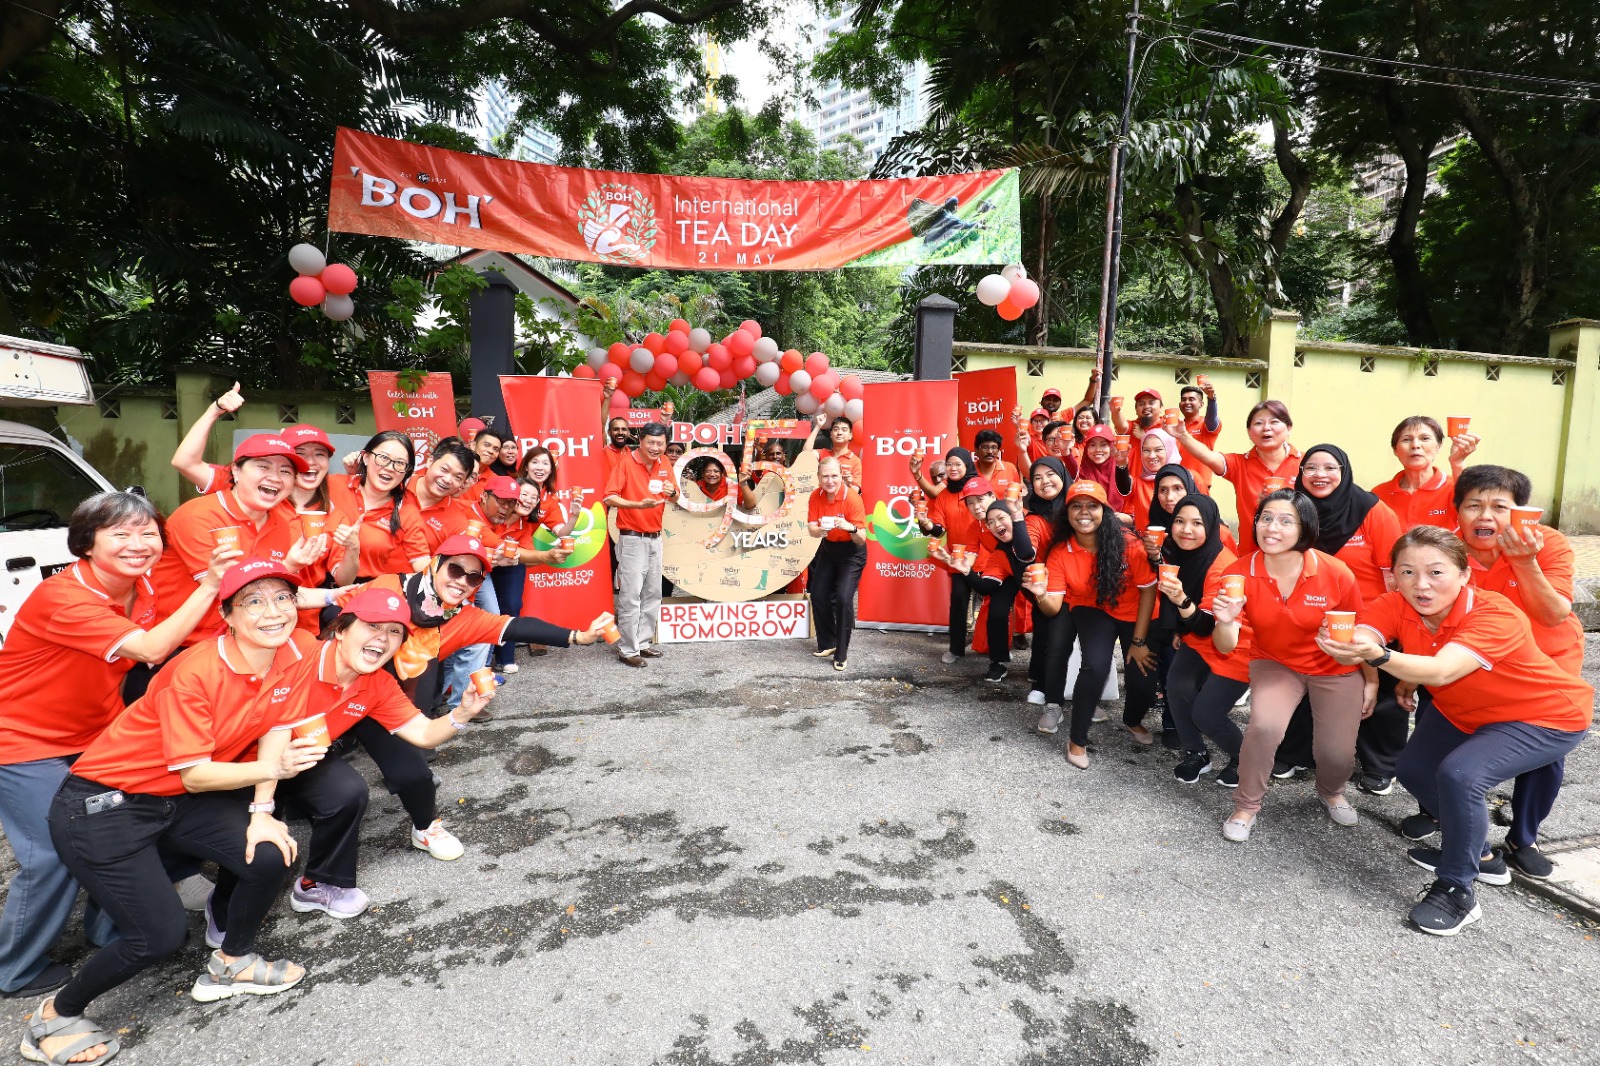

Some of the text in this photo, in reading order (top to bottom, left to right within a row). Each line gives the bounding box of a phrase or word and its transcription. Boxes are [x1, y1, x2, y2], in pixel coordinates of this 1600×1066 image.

[605, 191, 632, 201] BOH
[675, 195, 798, 217] International
[675, 220, 799, 248] TEA DAY
[698, 252, 776, 265] 21 MAY
[730, 531, 788, 548] YEARS
[876, 562, 936, 571] BREWING FOR
[529, 569, 594, 581] BREWING FOR
[880, 570, 932, 578] TOMORROW
[533, 577, 590, 588] TOMORROW
[660, 603, 806, 622] BREWING FOR
[669, 620, 797, 640] TOMORROW
